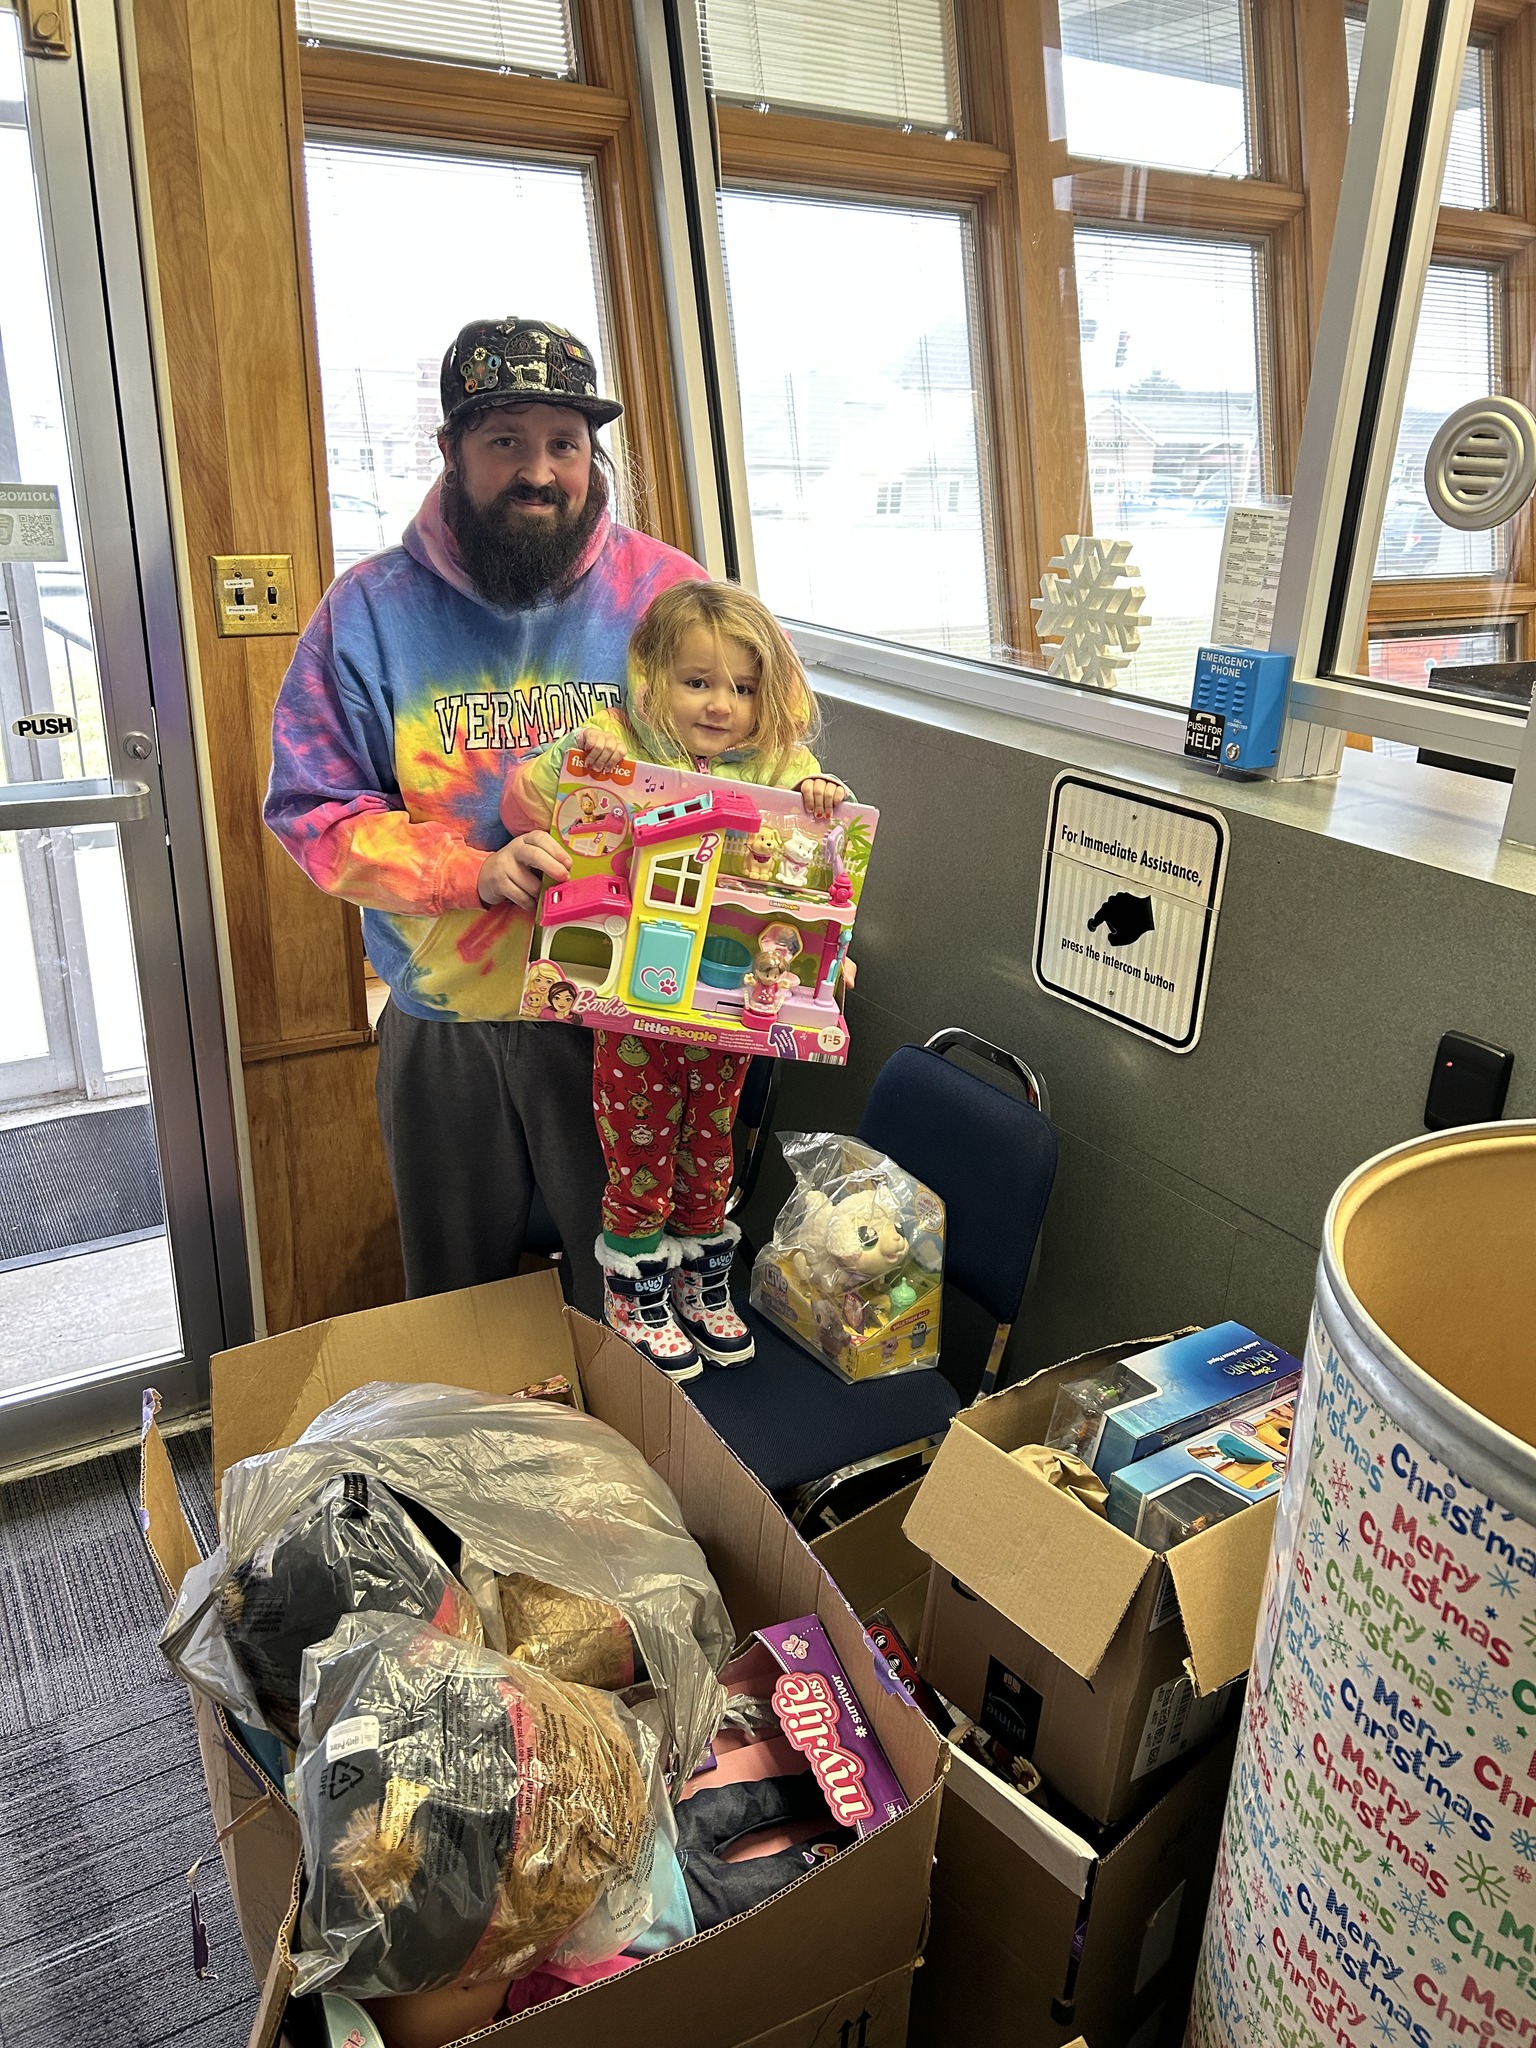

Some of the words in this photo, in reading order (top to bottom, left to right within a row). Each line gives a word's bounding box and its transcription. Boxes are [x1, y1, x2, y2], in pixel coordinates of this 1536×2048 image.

[1201, 651, 1256, 670] EMERGENCY
[1210, 664, 1241, 678] PHONE
[17, 717, 74, 737] PUSH
[434, 681, 622, 755] VERMONT
[1185, 730, 1221, 751] HELP
[1187, 720, 1207, 732] PUSH
[1207, 725, 1223, 736] FOR
[1061, 824, 1079, 843] For
[1080, 830, 1138, 863] Immediate
[1140, 849, 1203, 887] Assistance,
[1061, 937, 1084, 954] press
[1085, 944, 1100, 961] the
[1102, 951, 1141, 979] intercom
[1143, 967, 1176, 993] button
[572, 987, 632, 1018] Barbie
[1222, 1349, 1280, 1376] ENCANTO
[1325, 1346, 1369, 1425] Merry
[1319, 1390, 1385, 1494] ristmas
[1391, 1502, 1482, 1594] Merry
[1352, 1552, 1427, 1644] Merry
[1359, 1510, 1514, 1668] Christmas
[1325, 1558, 1455, 1717] Christmas
[780, 1678, 833, 1743] life
[808, 1677, 827, 1698] as
[830, 1674, 862, 1725] survivor
[985, 1700, 1027, 1741] prime
[1373, 1674, 1464, 1769] Merry
[318, 1768, 330, 1798] LDPE
[813, 1747, 866, 1819] my
[1341, 1677, 1495, 1842] Christmas
[1341, 1732, 1422, 1827] Merry
[635, 1830, 644, 1844] bag
[1306, 1769, 1373, 1864] Merry
[1312, 1732, 1450, 1899] Christmas
[630, 1852, 640, 1866] not
[1284, 1768, 1397, 1936] Christmas
[1296, 1882, 1433, 2048] Christmas
[1325, 1887, 1404, 1982] Merry
[1297, 1932, 1368, 2027] Merry
